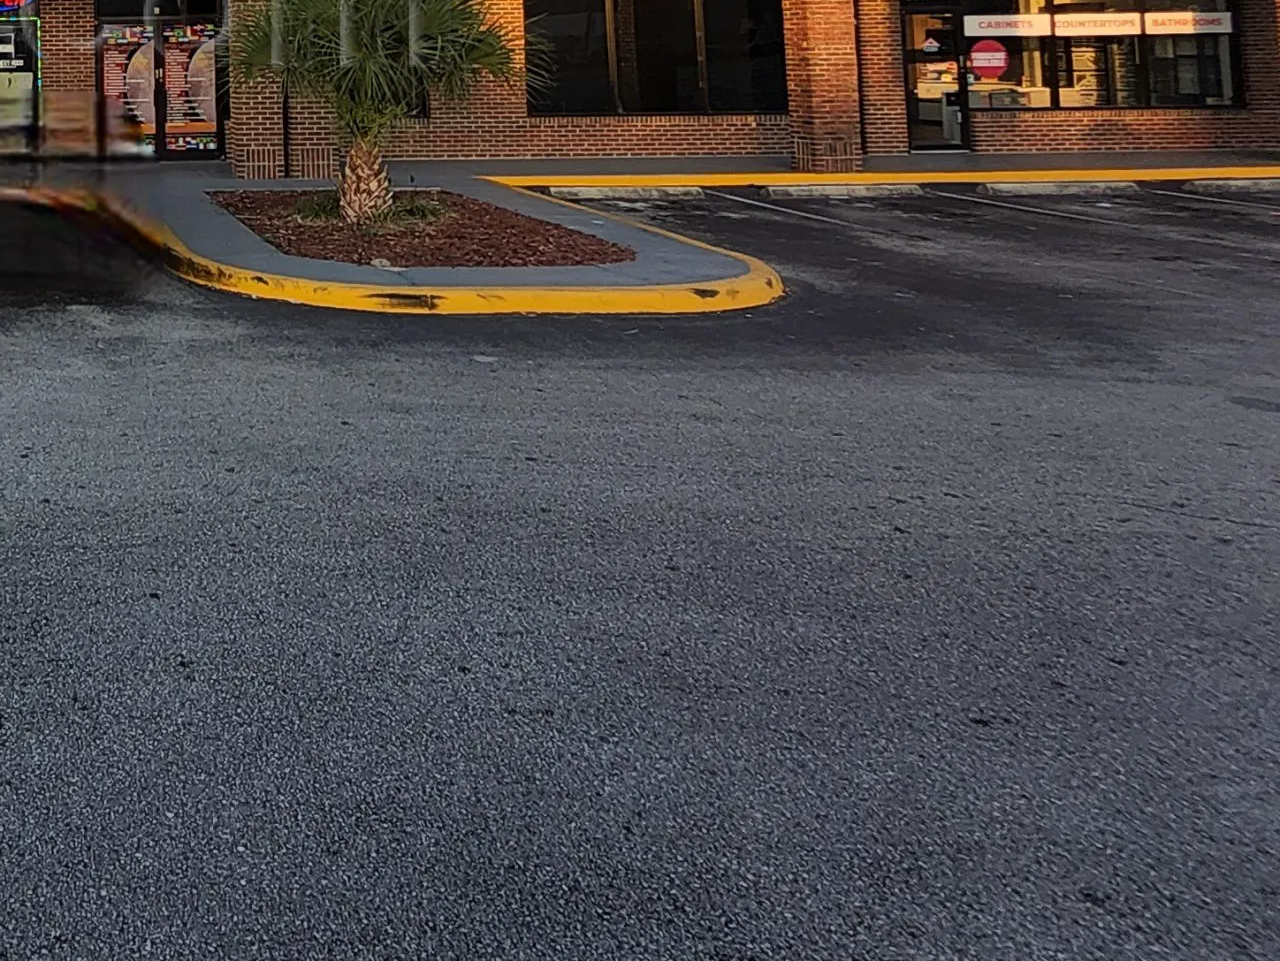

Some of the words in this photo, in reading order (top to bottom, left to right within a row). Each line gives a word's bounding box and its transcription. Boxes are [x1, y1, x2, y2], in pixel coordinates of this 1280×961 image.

[977, 20, 1033, 30] CABINETS
[1055, 19, 1136, 28] COUNTERTOPS
[1152, 18, 1223, 27] BATHROOMS
